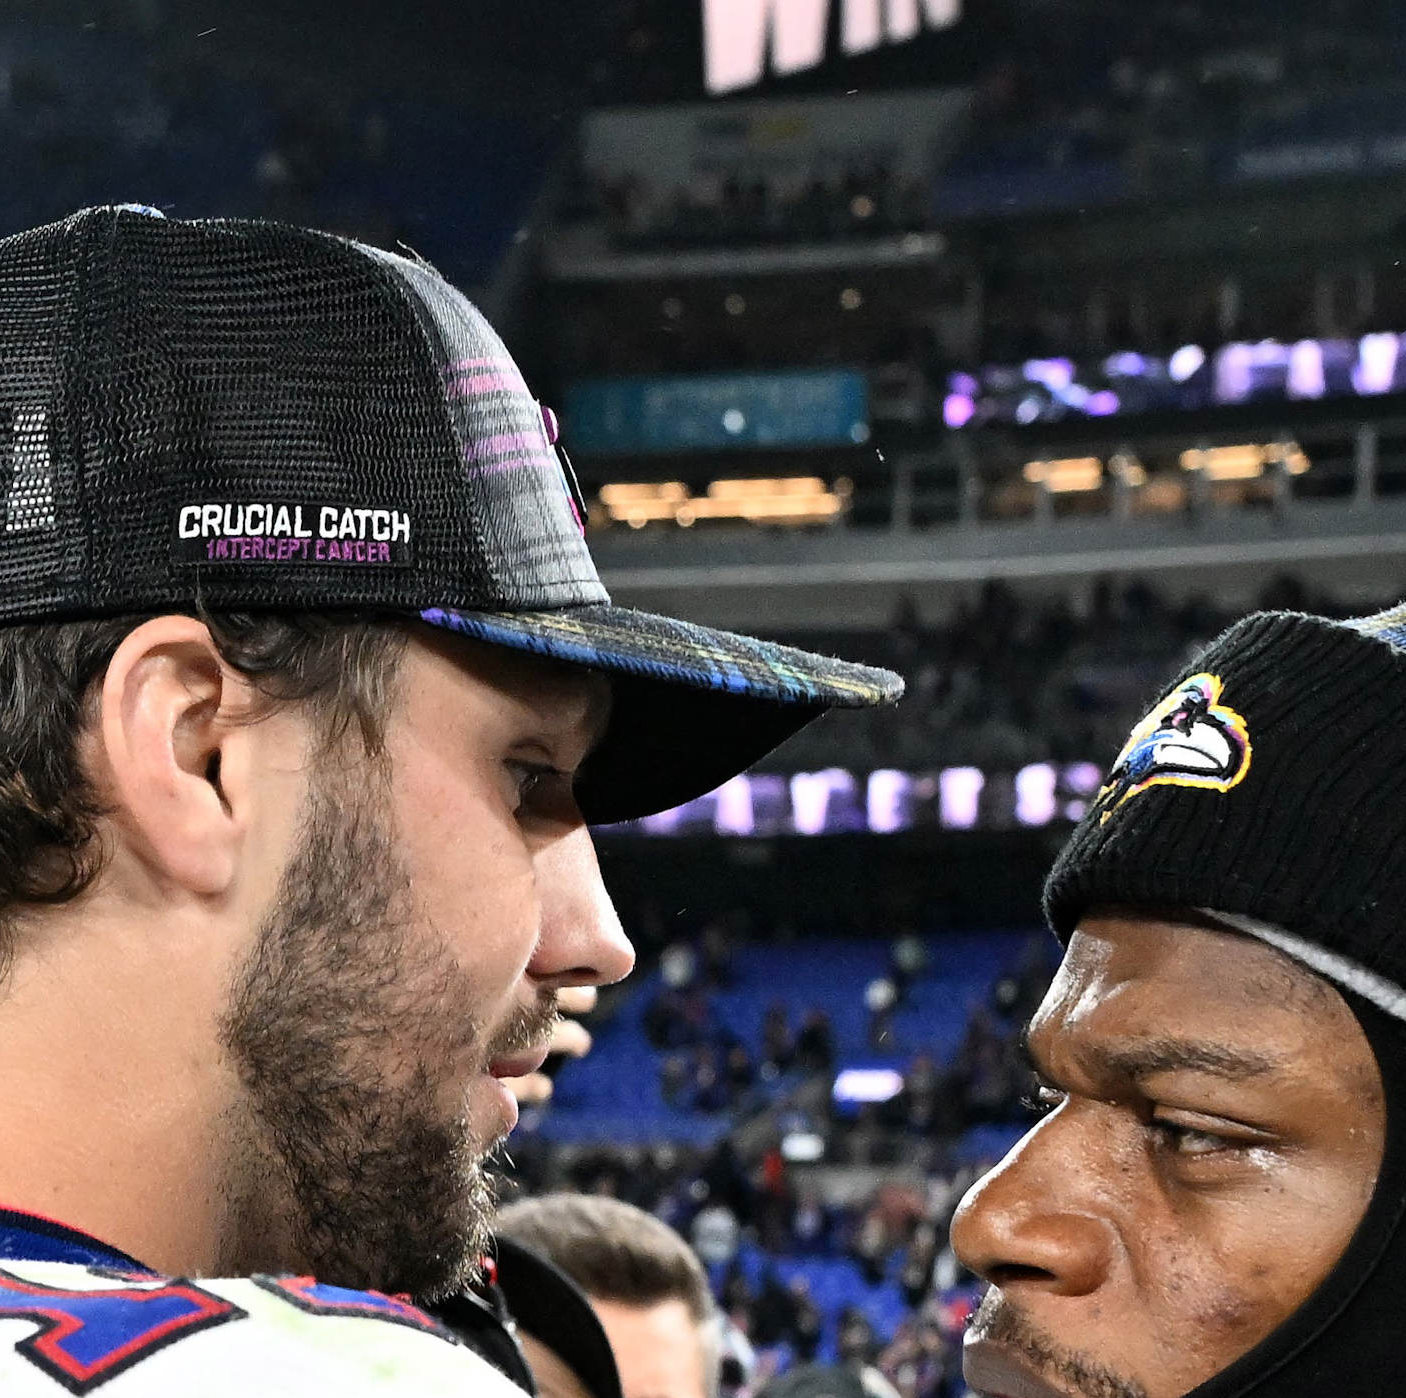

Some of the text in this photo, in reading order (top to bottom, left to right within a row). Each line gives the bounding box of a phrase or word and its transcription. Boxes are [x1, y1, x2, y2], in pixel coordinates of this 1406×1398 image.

[178, 503, 411, 543] CRUCIAL CATCH
[206, 537, 392, 563] INTERCEPT CANCER
